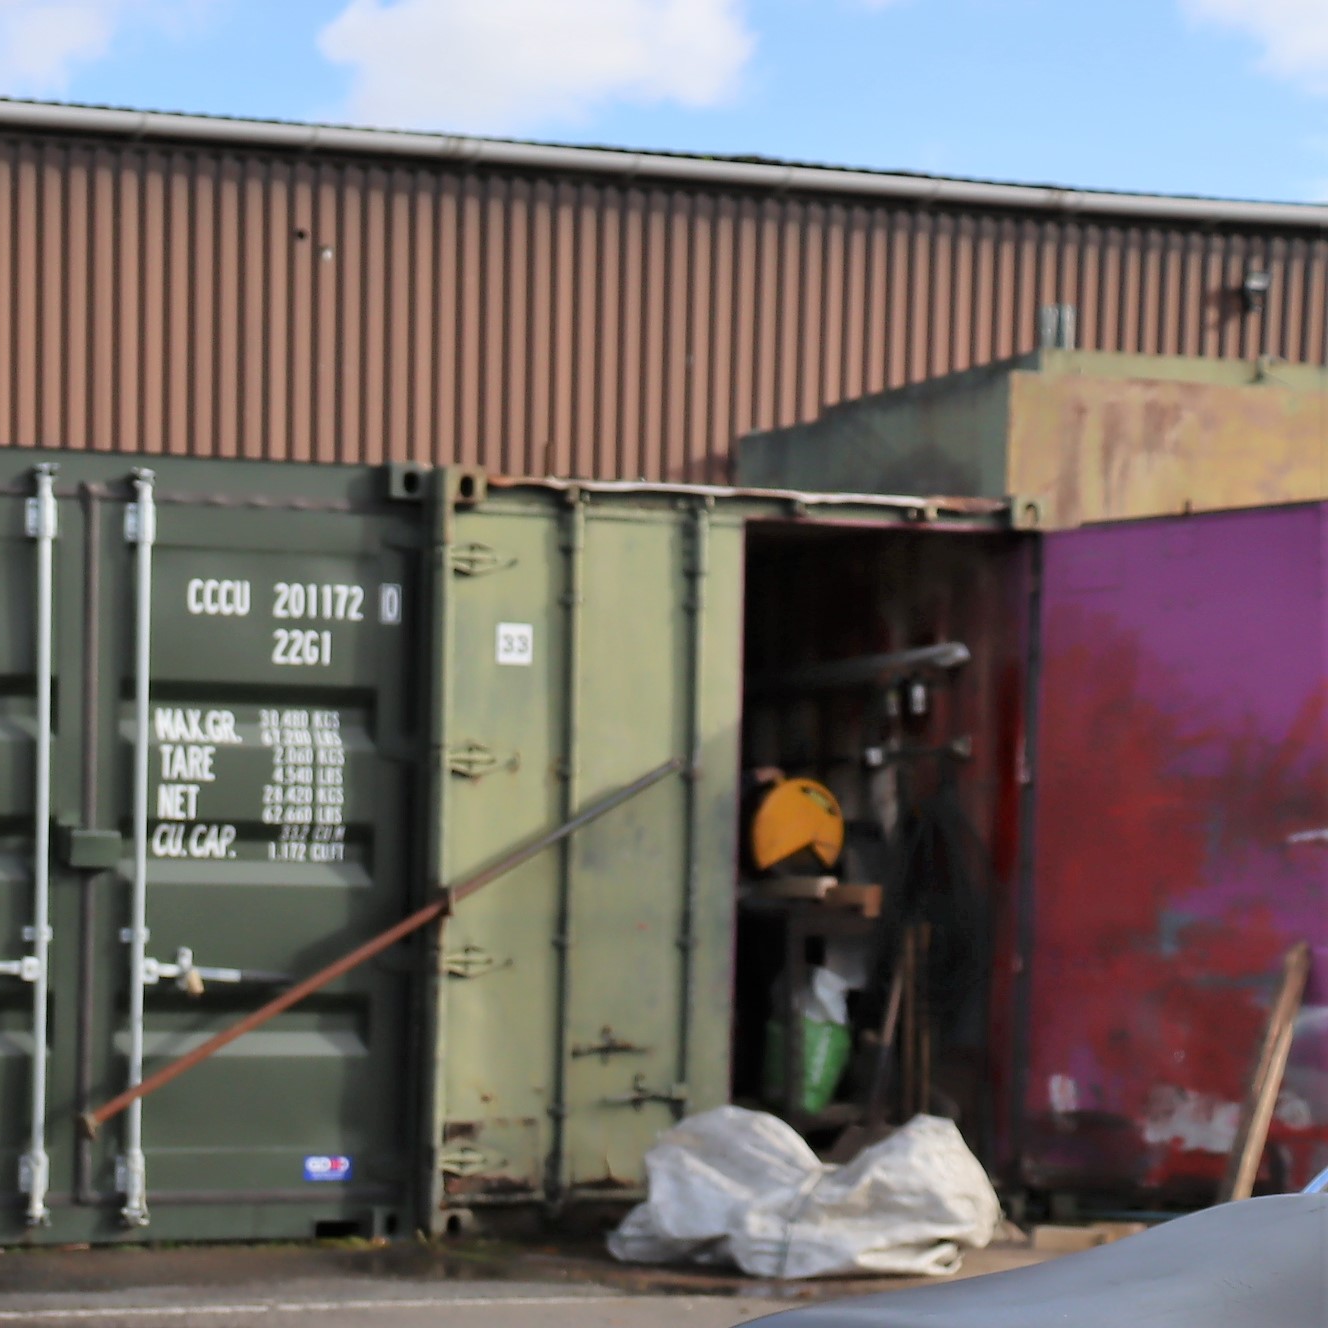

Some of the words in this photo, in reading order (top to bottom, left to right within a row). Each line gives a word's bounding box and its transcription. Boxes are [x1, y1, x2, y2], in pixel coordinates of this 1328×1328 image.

[187, 578, 251, 616] CCCU
[272, 582, 365, 622] 201172
[272, 628, 332, 667] 22G1
[503, 633, 529, 654] 33
[160, 744, 216, 781] TARE
[157, 783, 200, 820] NET
